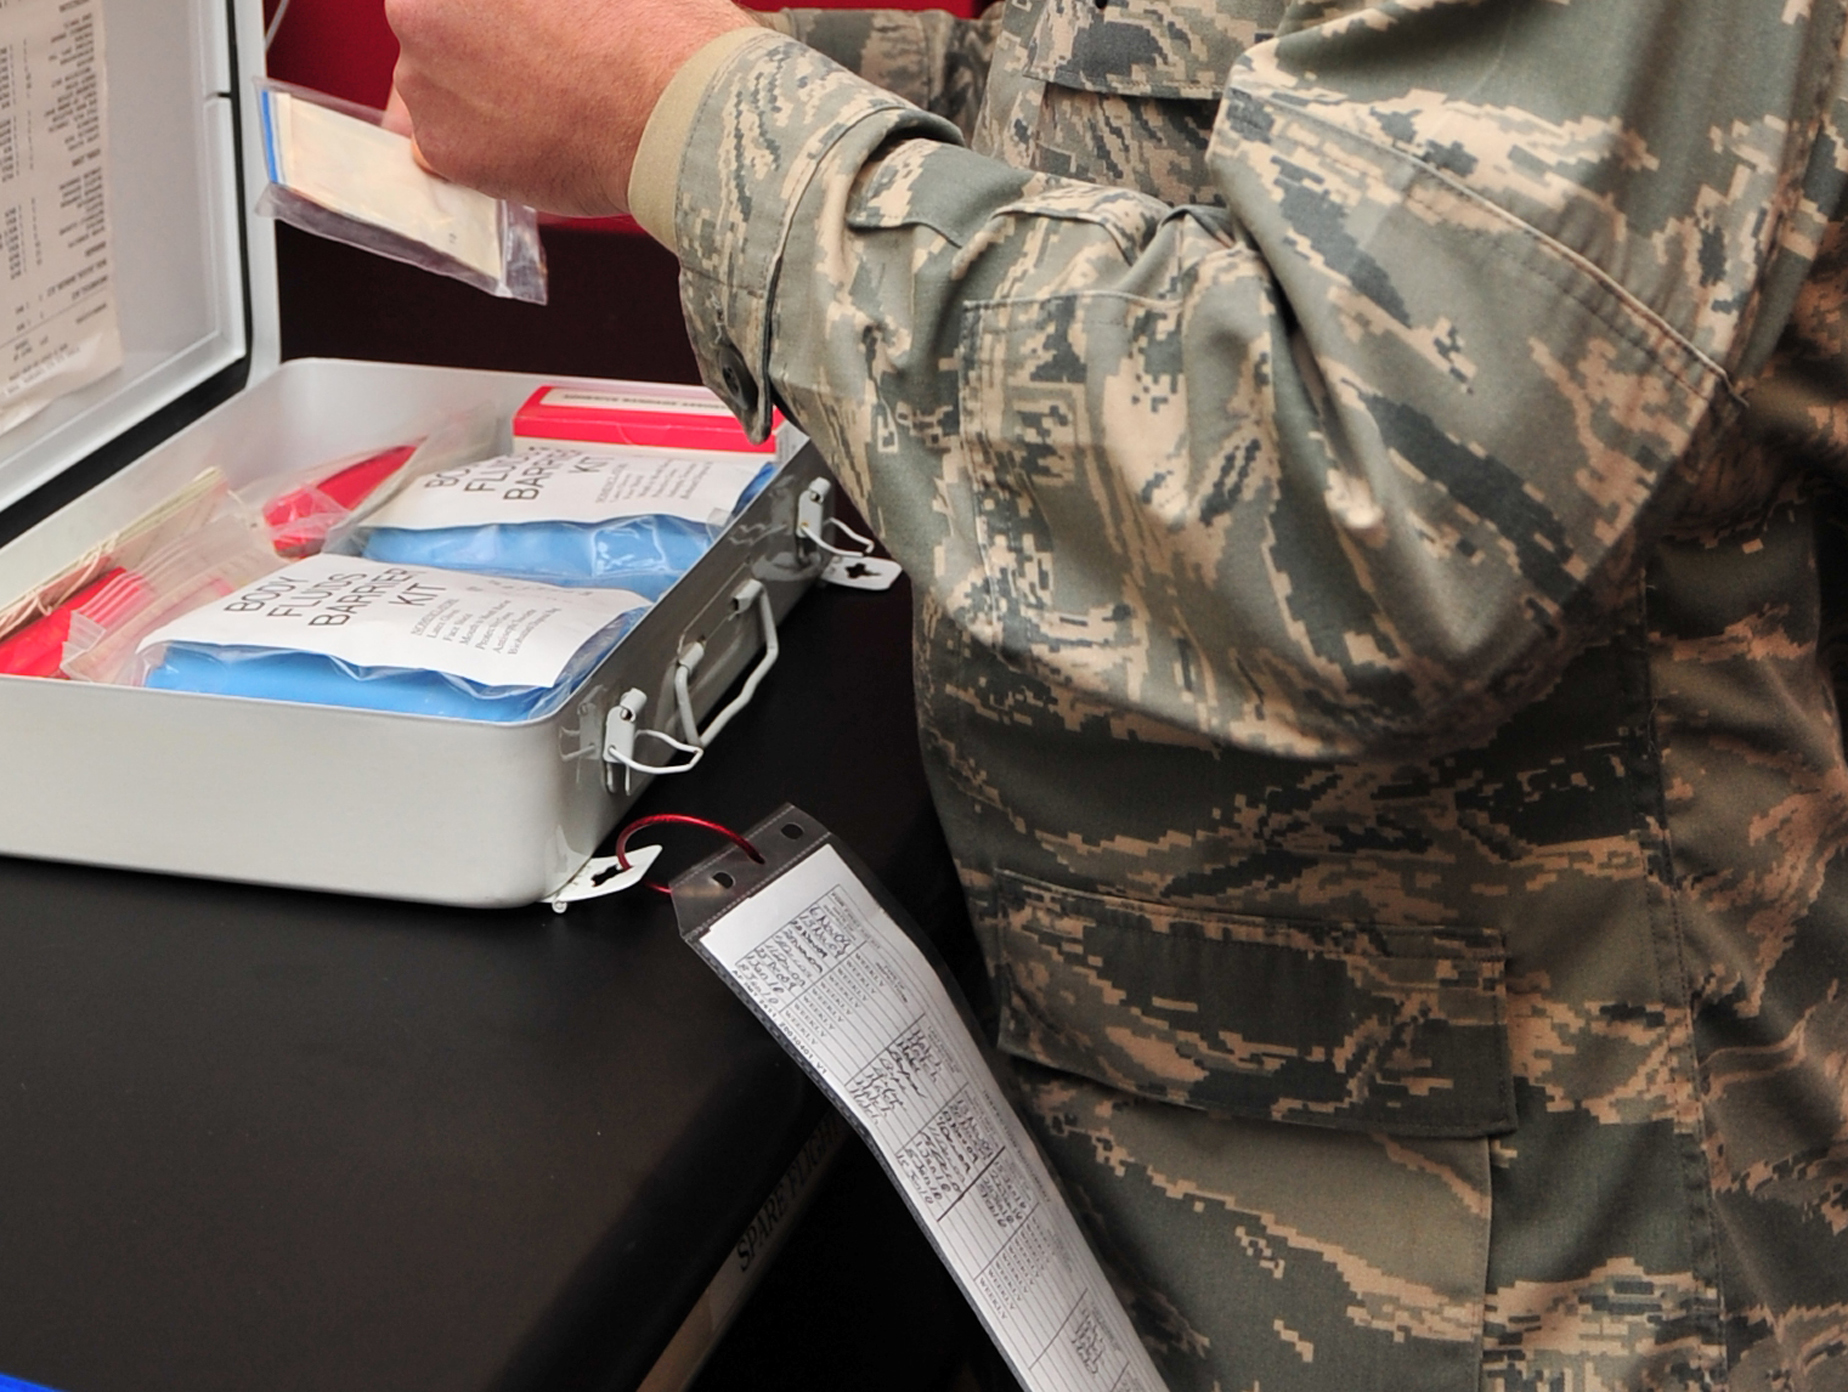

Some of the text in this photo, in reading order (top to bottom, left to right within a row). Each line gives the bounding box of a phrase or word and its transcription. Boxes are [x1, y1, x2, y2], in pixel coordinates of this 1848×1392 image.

[223, 576, 309, 612] BODY
[266, 572, 368, 618] FLUIDS
[308, 567, 427, 626] BARRIER
[388, 582, 447, 607] KIT
[835, 966, 869, 1004] WEEKLY
[843, 959, 877, 996] WEEKLY
[852, 951, 886, 989] WEEKLY
[809, 987, 844, 1025] WEEKLY
[817, 980, 852, 1018] WEEKLY
[826, 973, 860, 1011] WEEKLY
[783, 1008, 818, 1048] WEEKLY
[791, 1001, 827, 1040] WEEKLY
[800, 994, 836, 1032] WEEKLY
[737, 1183, 785, 1272] SPARE
